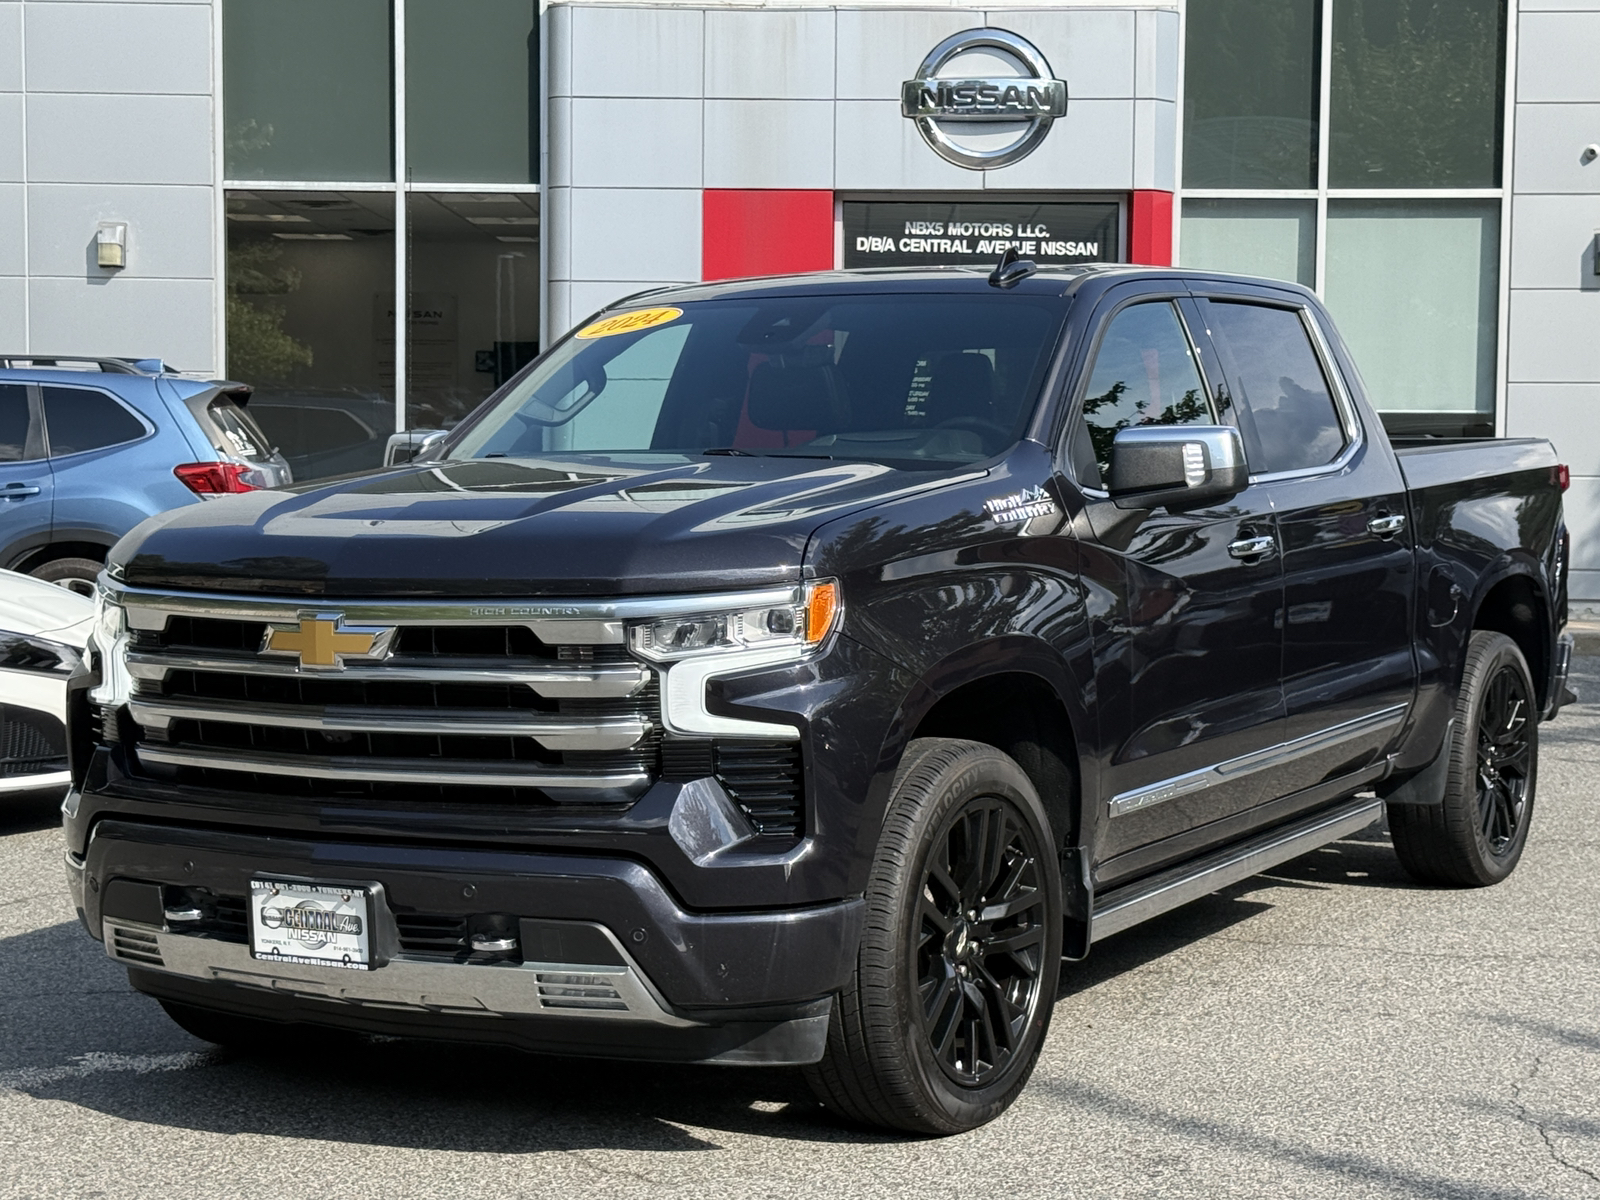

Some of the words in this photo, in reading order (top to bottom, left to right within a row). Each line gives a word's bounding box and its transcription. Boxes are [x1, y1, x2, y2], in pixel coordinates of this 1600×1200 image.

[917, 84, 1051, 110] NISSAN
[904, 221, 944, 236] NBX5
[947, 222, 1014, 237] MOTORS
[1017, 224, 1050, 238] LLC.
[856, 236, 895, 253] D/B/A
[899, 237, 973, 254] CENTRAL
[1040, 241, 1098, 257] NISSAN
[587, 310, 669, 335] 2024
[470, 607, 506, 616] HIGH
[510, 606, 581, 615] COUNTRY
[924, 766, 979, 841] VELOCITY
[284, 907, 339, 932] CENTRAL
[339, 916, 361, 933] Ave.
[287, 928, 338, 944] NISSAN
[255, 952, 369, 971] CentralAveNissan.com
